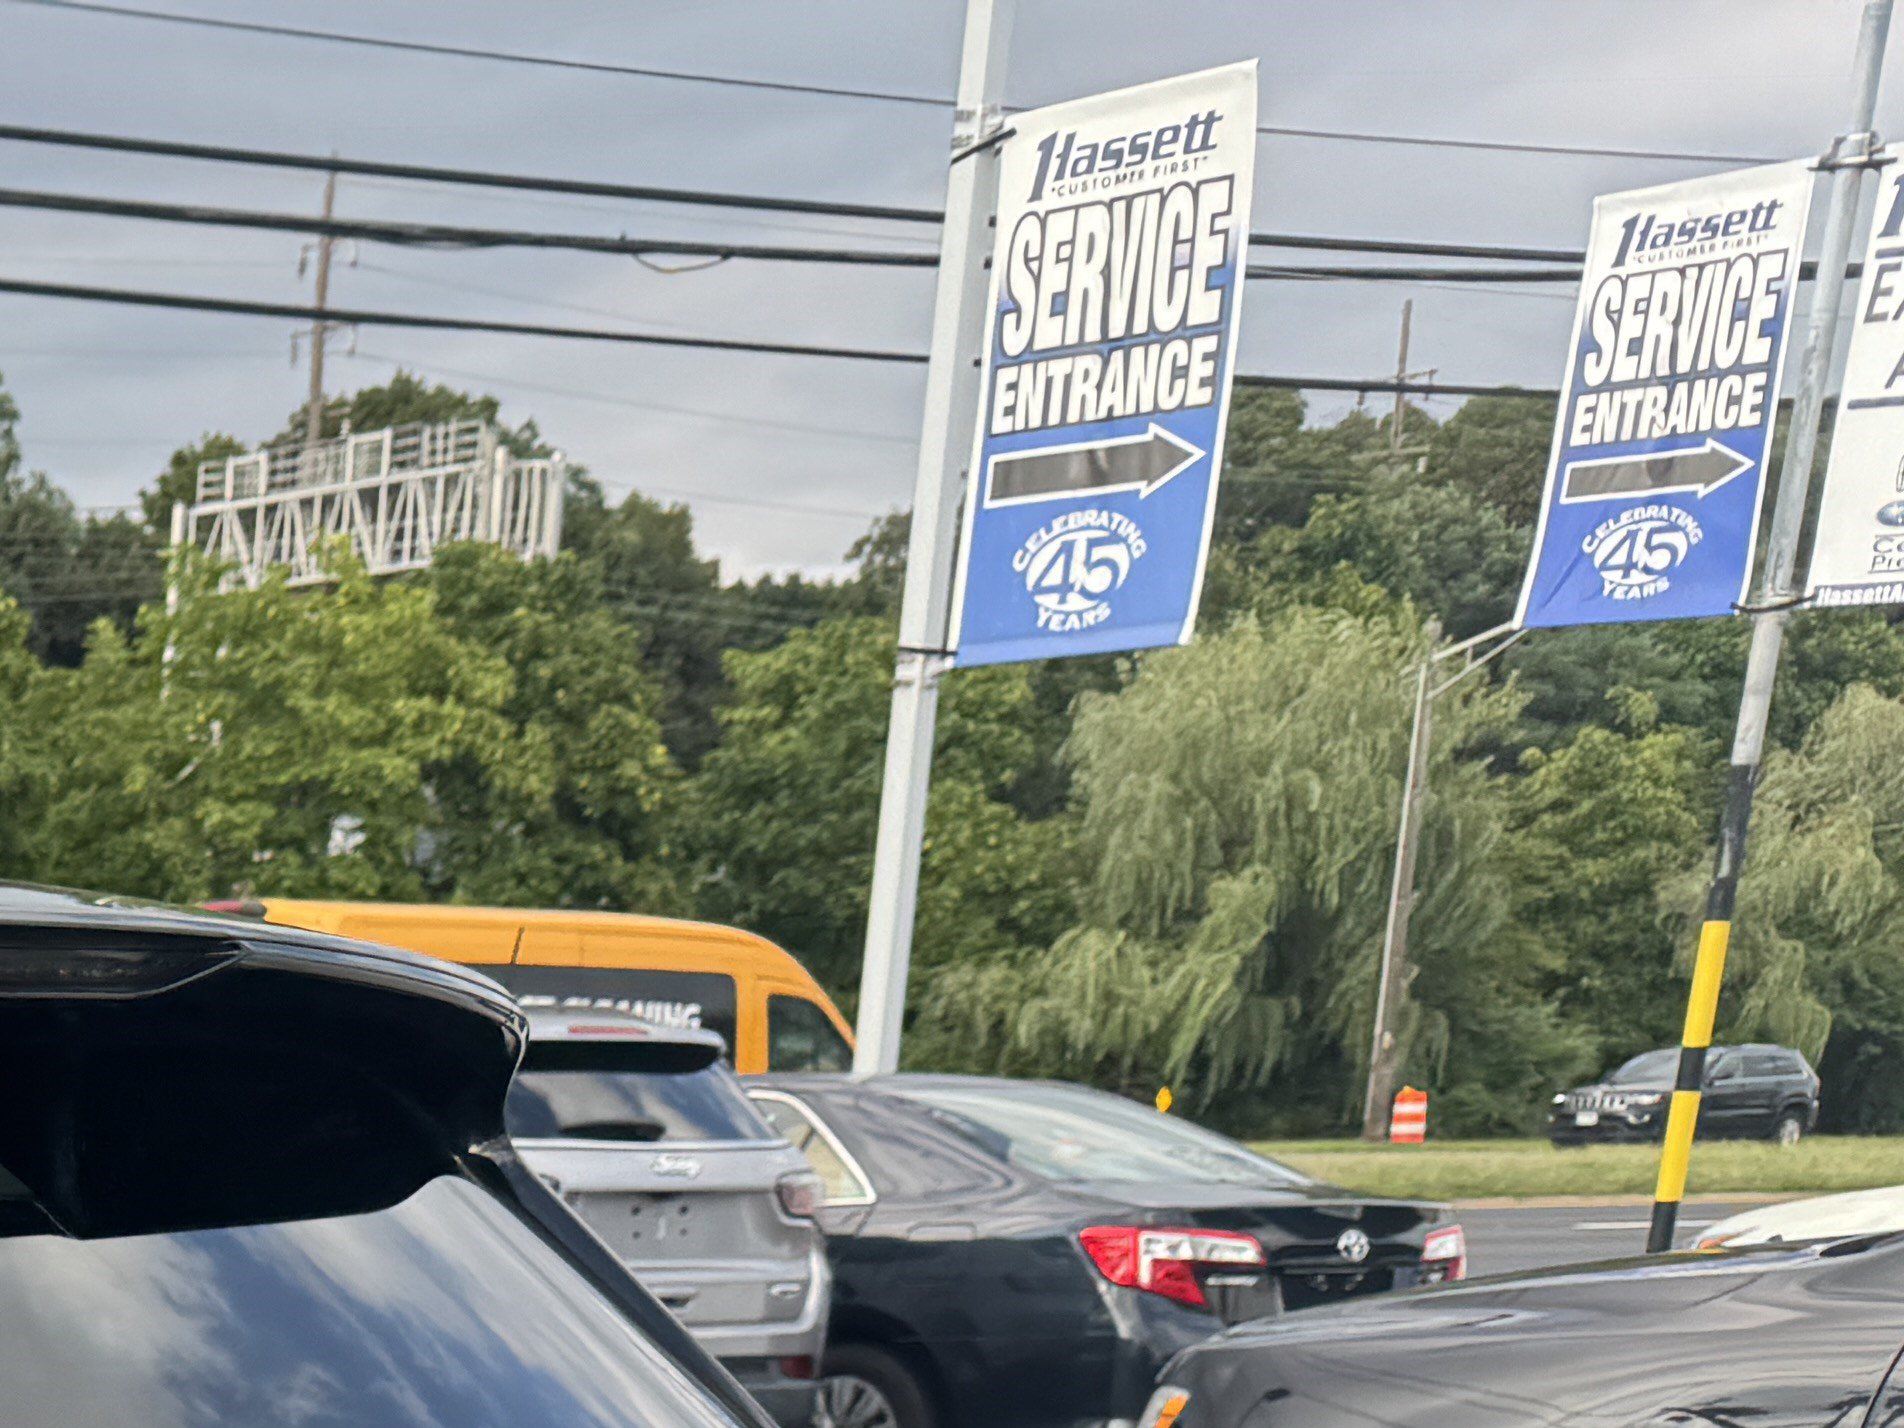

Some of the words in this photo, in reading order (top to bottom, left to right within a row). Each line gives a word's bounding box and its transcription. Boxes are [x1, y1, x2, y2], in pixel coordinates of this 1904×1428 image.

[1028, 110, 1223, 203] Hassett
[1000, 174, 1234, 358] SERVICE
[1611, 199, 1784, 268] Hassett
[1583, 248, 1790, 387] SERVICE
[1863, 262, 1904, 324] E
[990, 332, 1220, 437] ENTRANCE
[1569, 372, 1767, 447] ENTRANCE
[1012, 509, 1147, 572] CELEBRATING
[1582, 505, 1703, 553] CELEBRATING
[1596, 522, 1686, 581] 45
[1028, 533, 1128, 607] 45
[1603, 576, 1669, 600] YEARS
[1037, 602, 1111, 632] YEARS
[561, 996, 702, 1029] NING
